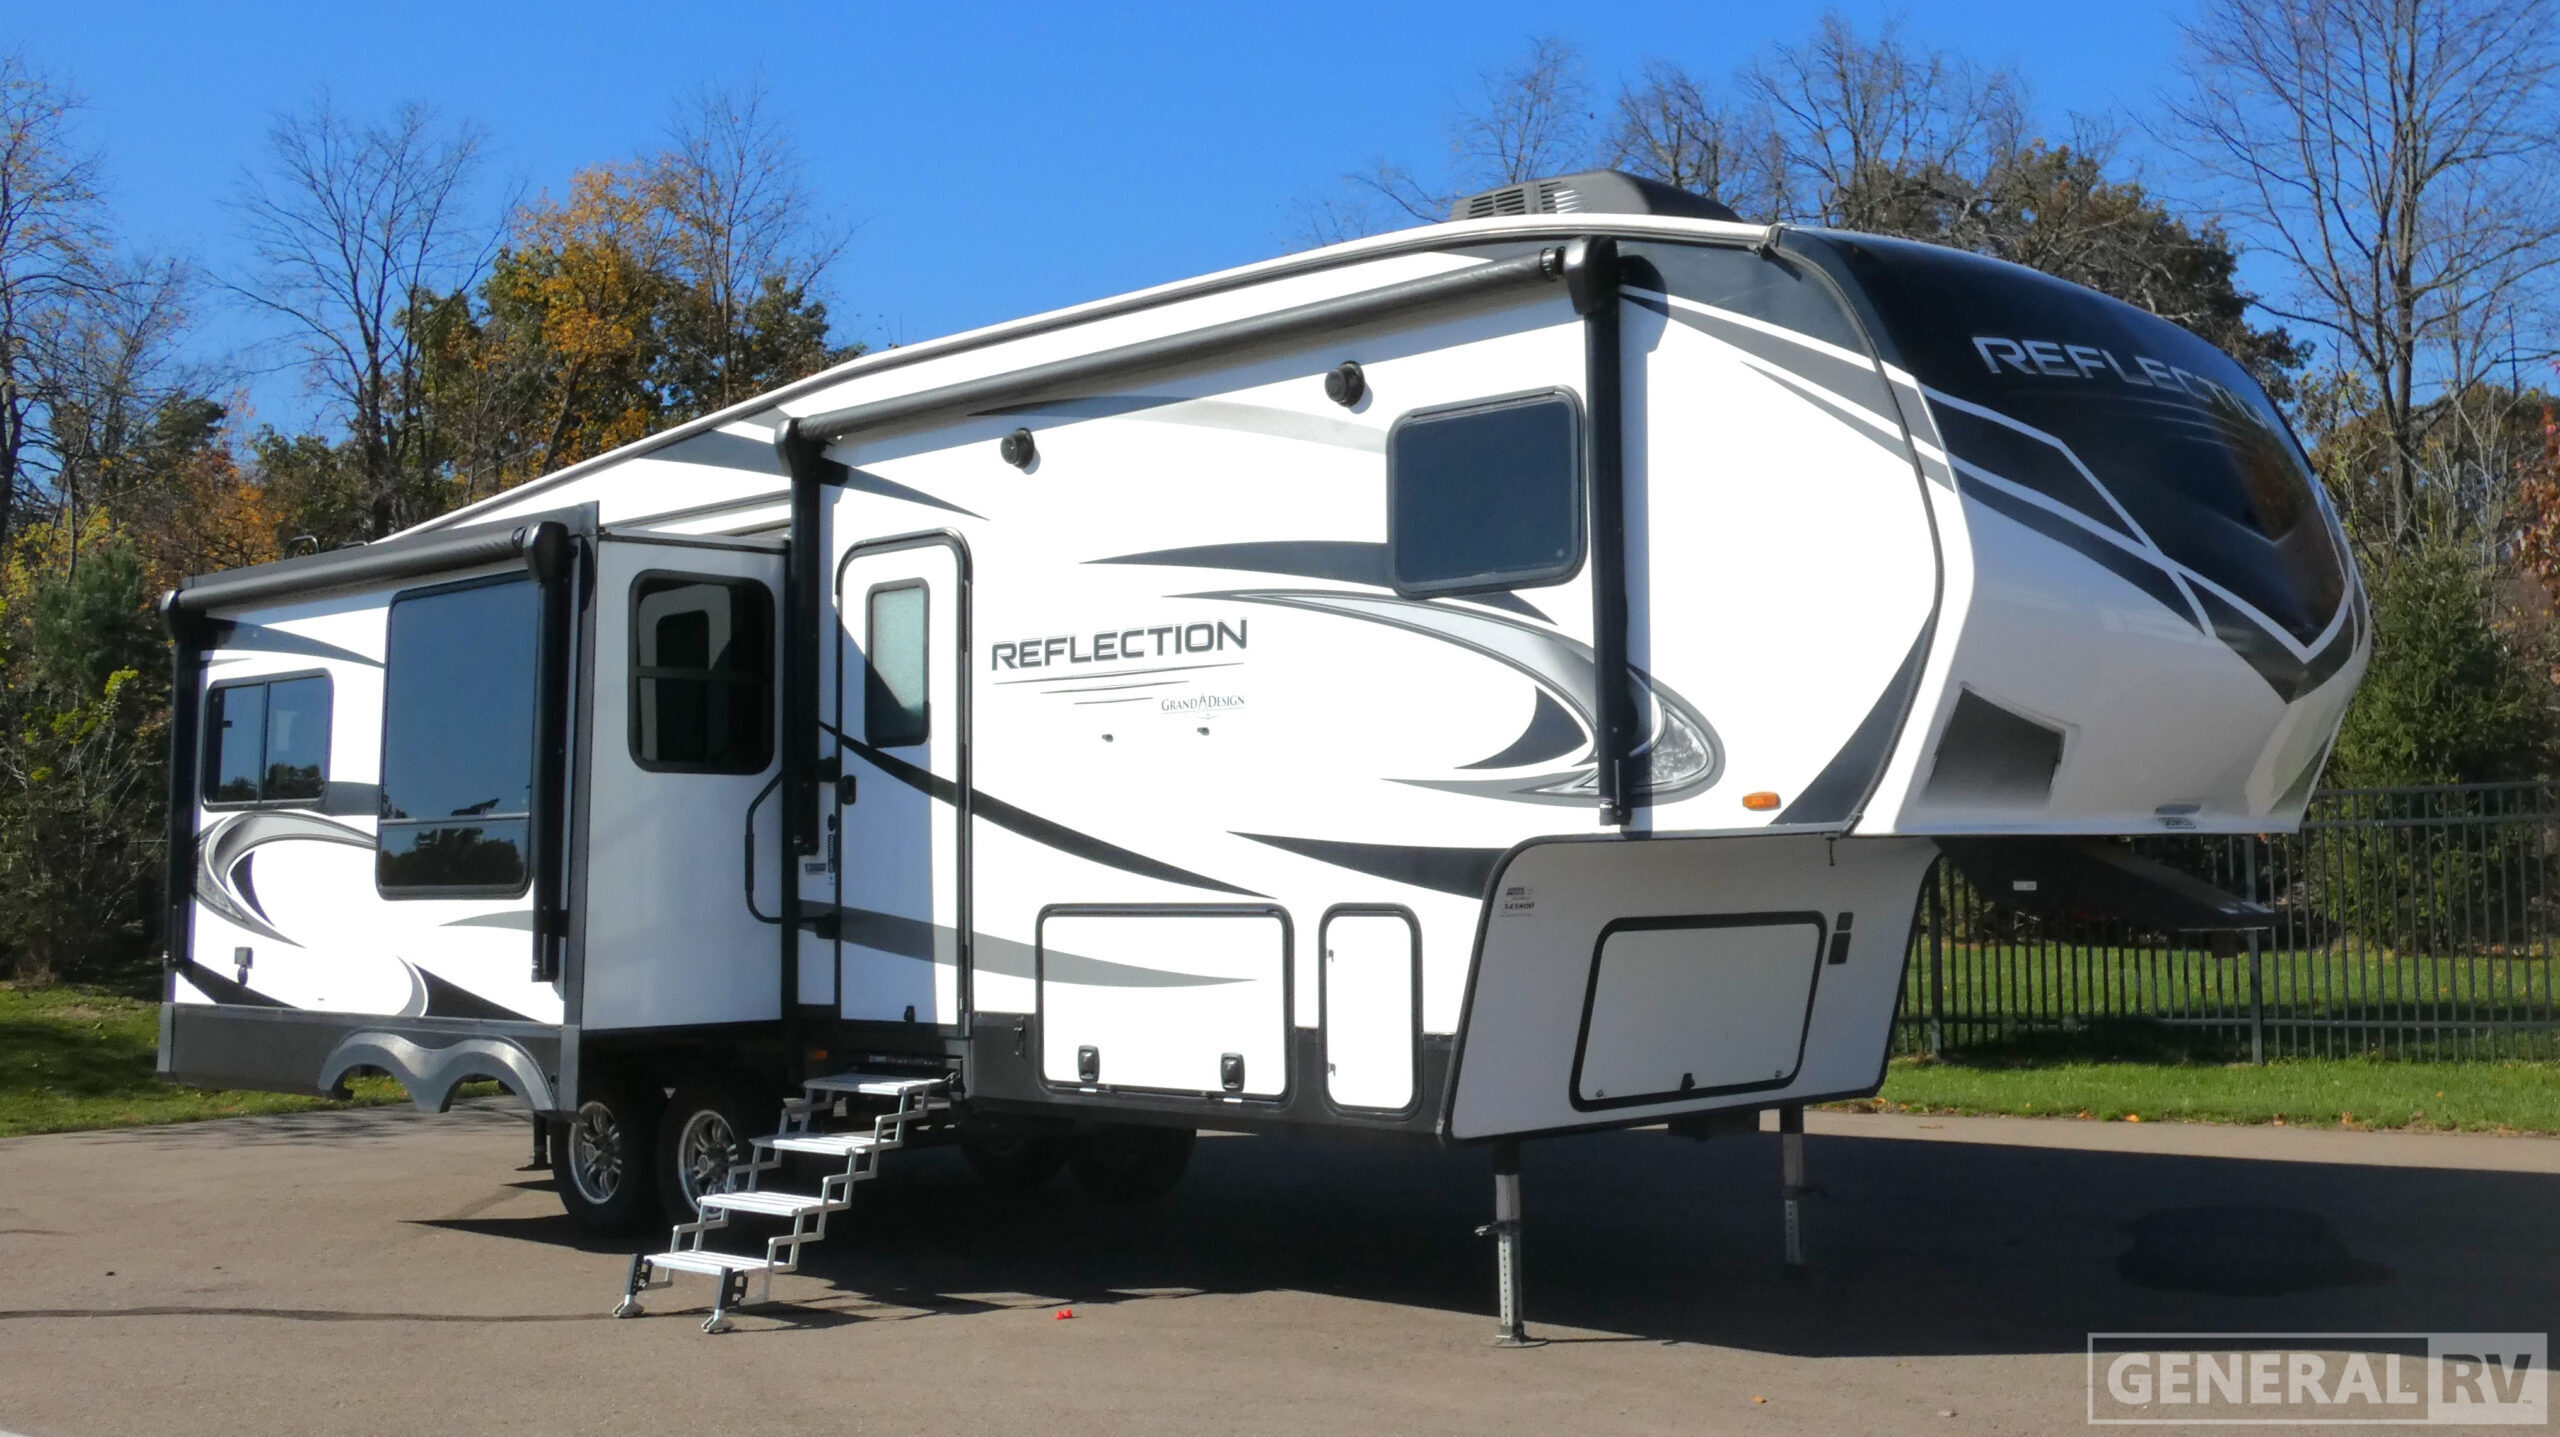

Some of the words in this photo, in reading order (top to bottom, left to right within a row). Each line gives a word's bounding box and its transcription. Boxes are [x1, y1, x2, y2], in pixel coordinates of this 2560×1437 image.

[1972, 336, 2269, 430] REFLECTIO
[991, 616, 1248, 671] REFLECTION
[1161, 698, 1198, 711] GRAND
[1208, 695, 1245, 708] DESIGN
